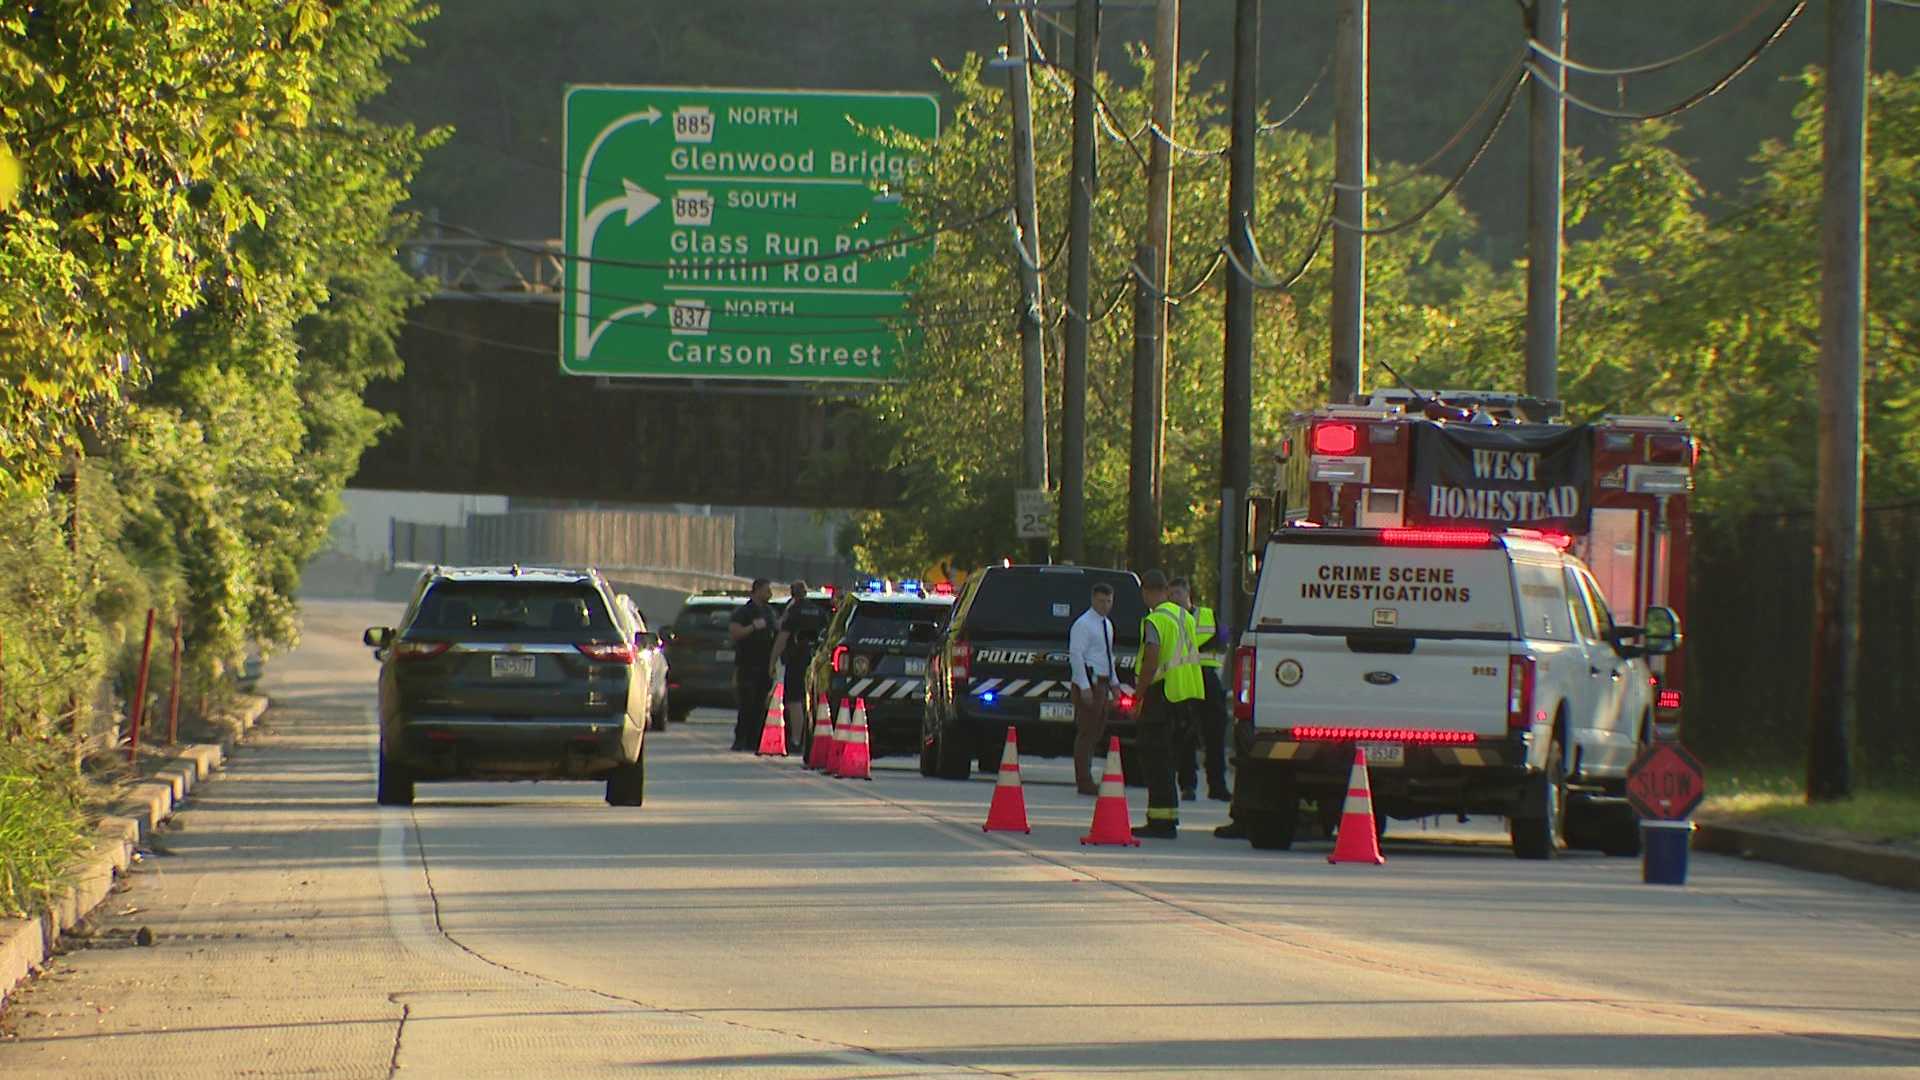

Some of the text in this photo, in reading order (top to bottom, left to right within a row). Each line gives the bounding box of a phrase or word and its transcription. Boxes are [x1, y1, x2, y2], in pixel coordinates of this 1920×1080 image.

[675, 107, 798, 135] 885 NORTH
[671, 148, 814, 172] Glenwood
[675, 191, 797, 217] 885 SOUTH
[671, 231, 749, 254] Glass
[766, 233, 819, 256] Run
[668, 258, 859, 284] Mifflin Road
[673, 300, 795, 327] 837 NORTH
[668, 341, 881, 367] Carson Street
[1473, 448, 1542, 482] WEST
[1429, 484, 1580, 522] HOMESTEAD
[1318, 565, 1455, 585] CRIME SCENE
[1301, 583, 1471, 603] INVESTIGATIONS
[858, 638, 908, 647] POLICE
[976, 650, 1036, 664] POLICE
[1639, 771, 1691, 798] SLOW
